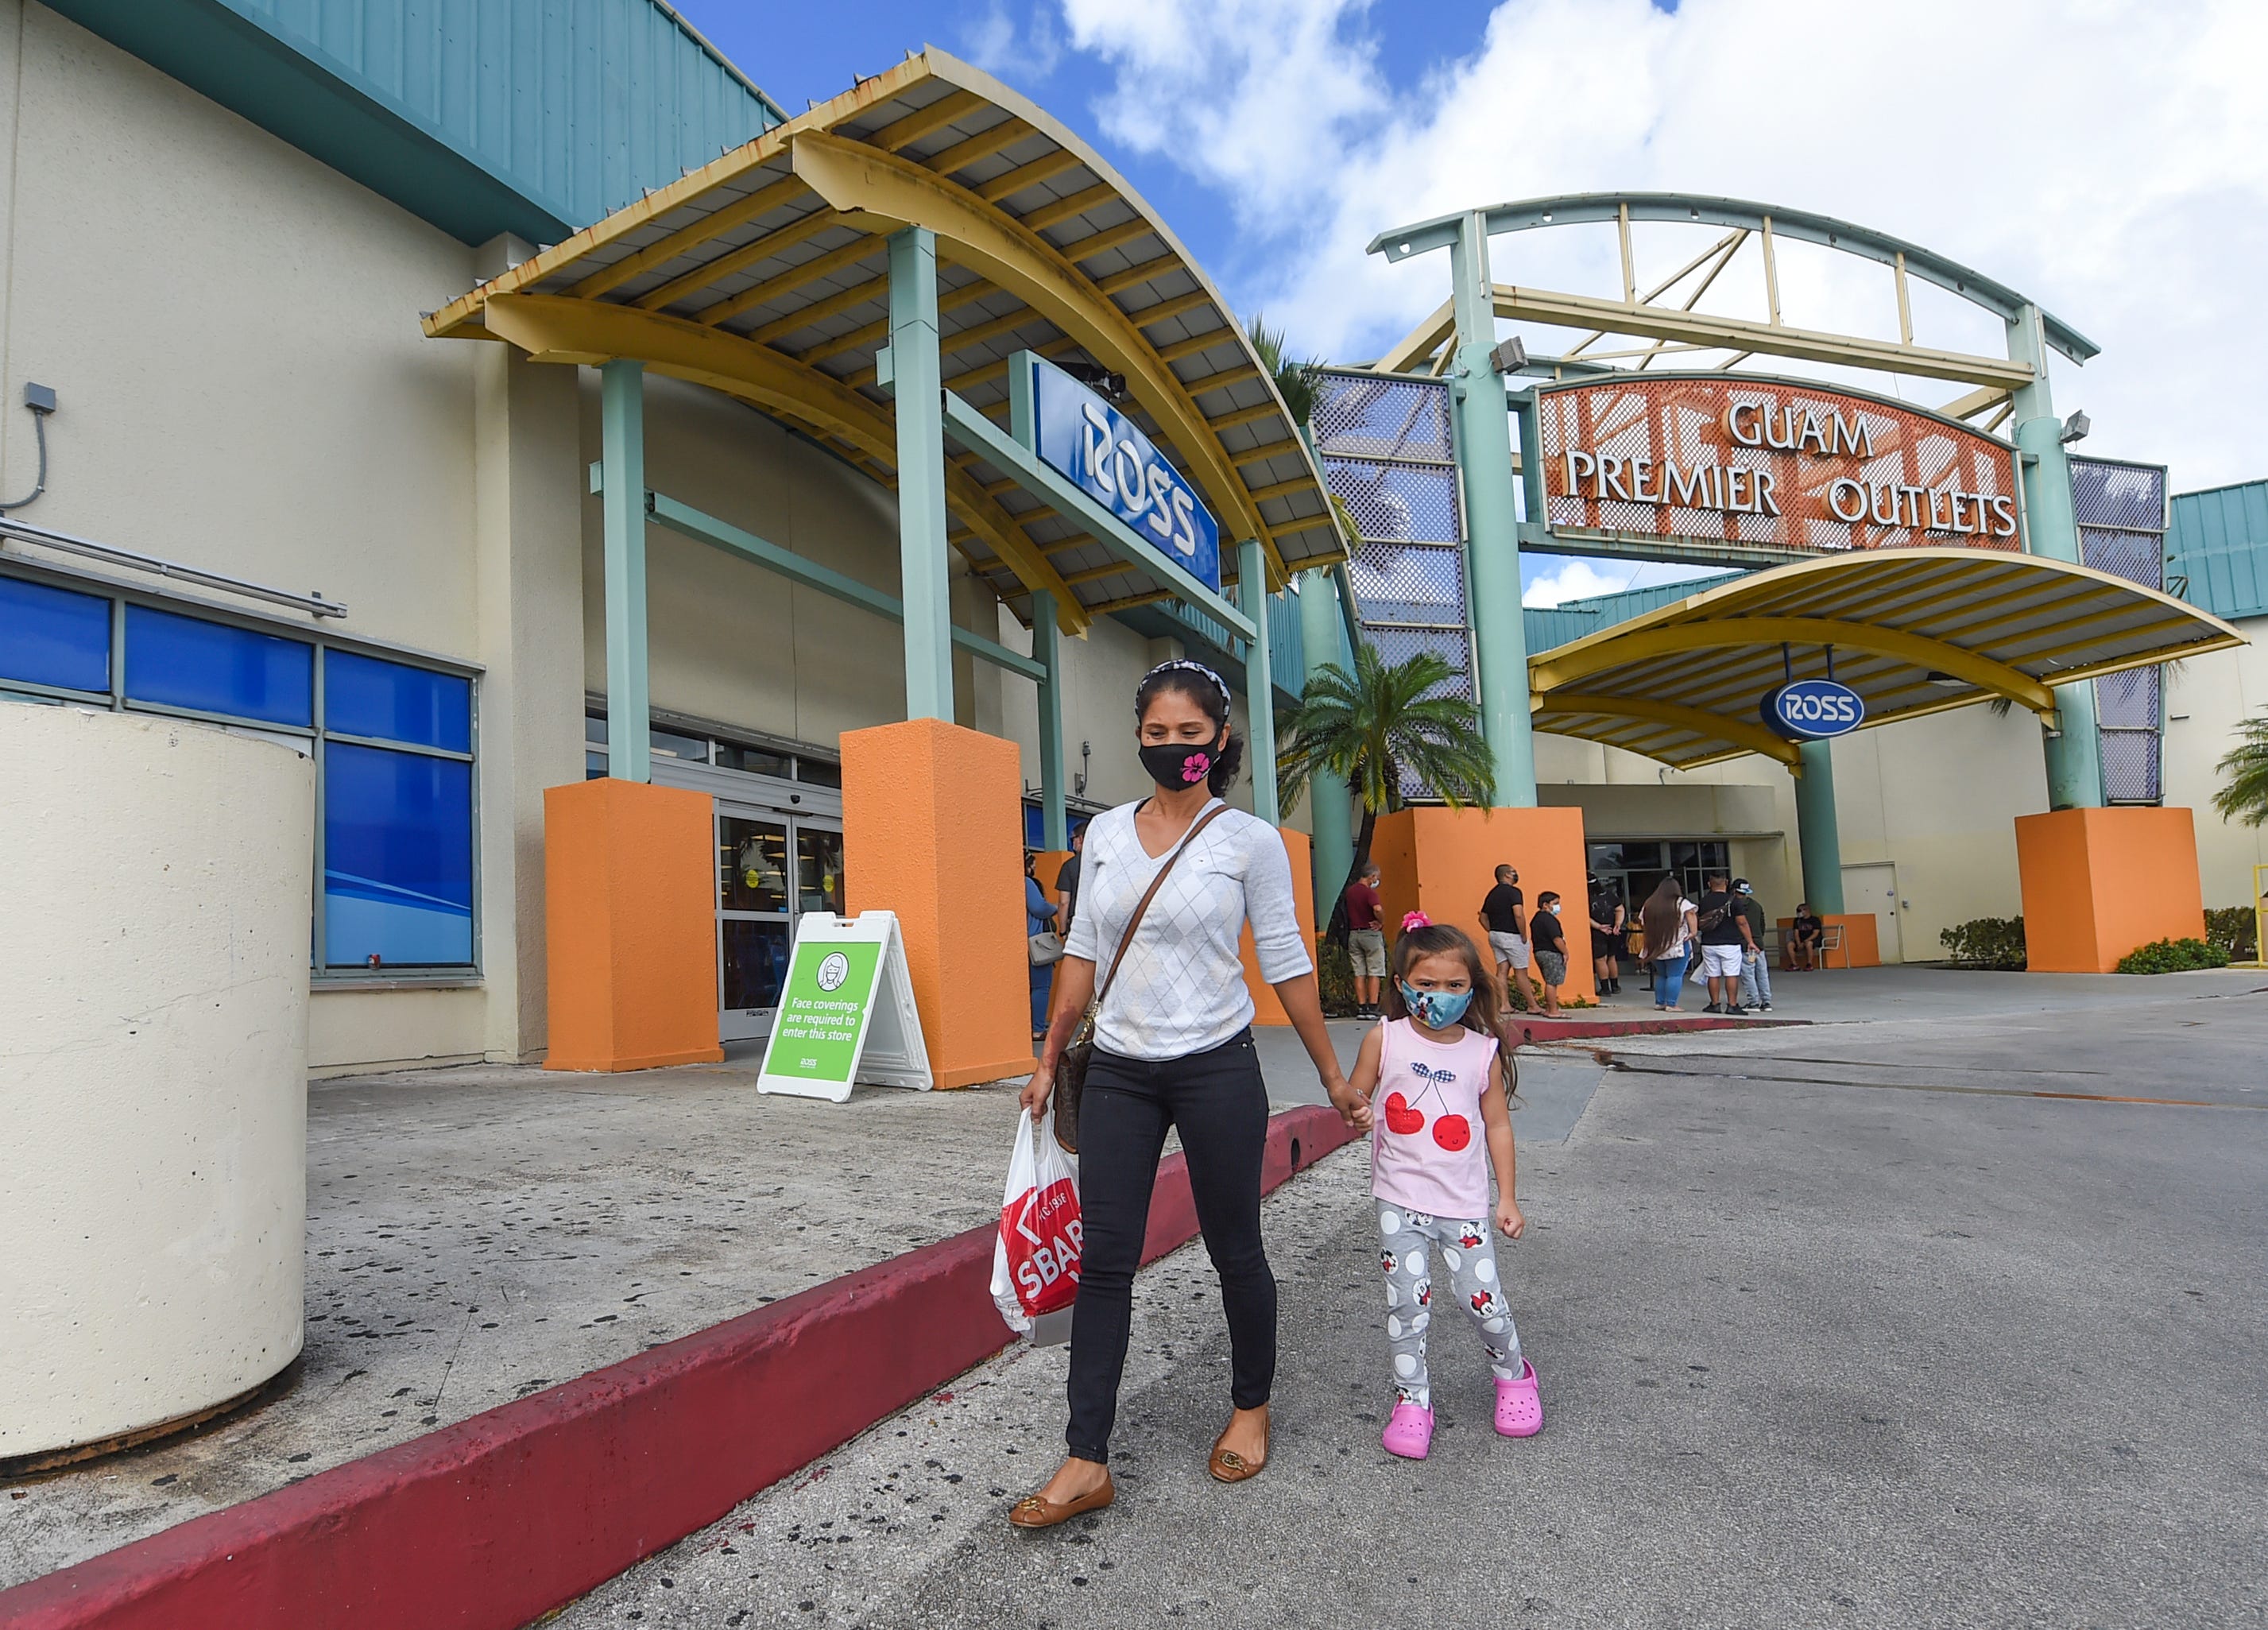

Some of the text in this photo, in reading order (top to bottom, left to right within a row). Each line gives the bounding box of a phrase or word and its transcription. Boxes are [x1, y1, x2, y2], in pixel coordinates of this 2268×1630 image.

[1728, 400, 1875, 459] GUAM
[1082, 401, 1195, 556] ROSS
[1563, 450, 2018, 538] PREMIER OUTLETS
[1785, 694, 1855, 722] ROSS
[787, 1014, 856, 1027] are required to
[792, 997, 858, 1013] Face coverings
[782, 1027, 853, 1041] enter this store
[1017, 1213, 1084, 1299] SBAR
